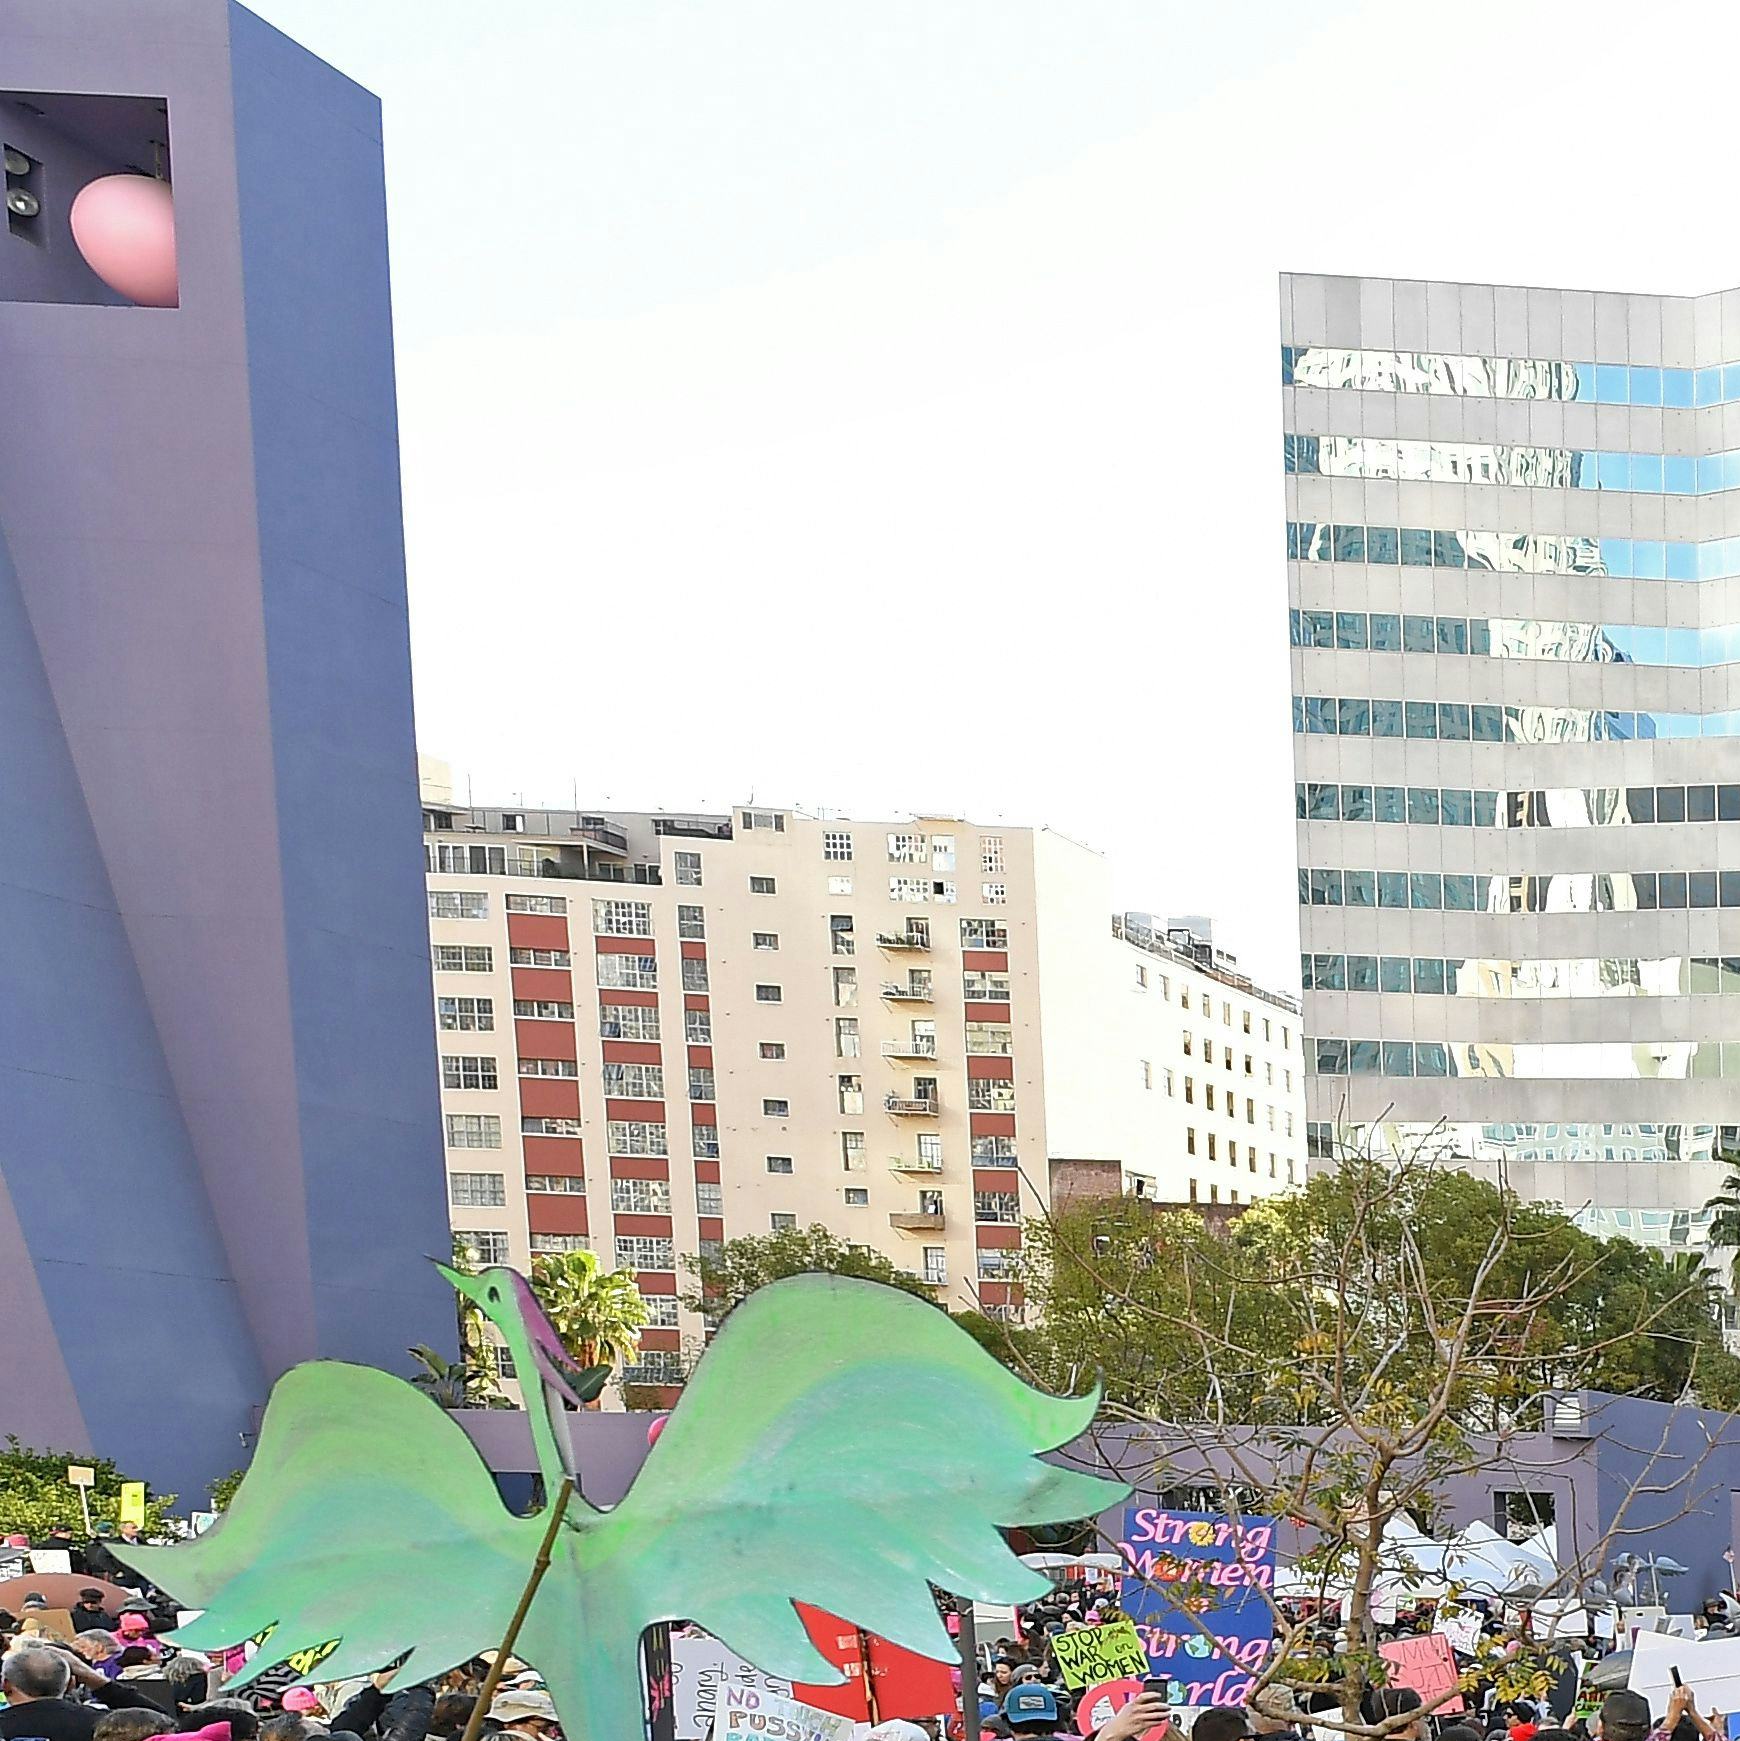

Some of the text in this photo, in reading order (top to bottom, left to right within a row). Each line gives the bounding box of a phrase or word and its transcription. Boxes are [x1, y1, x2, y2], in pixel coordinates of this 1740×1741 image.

[1055, 1627, 1103, 1653] STOP
[1061, 1646, 1102, 1669] WAR
[1071, 1652, 1146, 1685] WOMEN
[727, 1687, 760, 1709] NO
